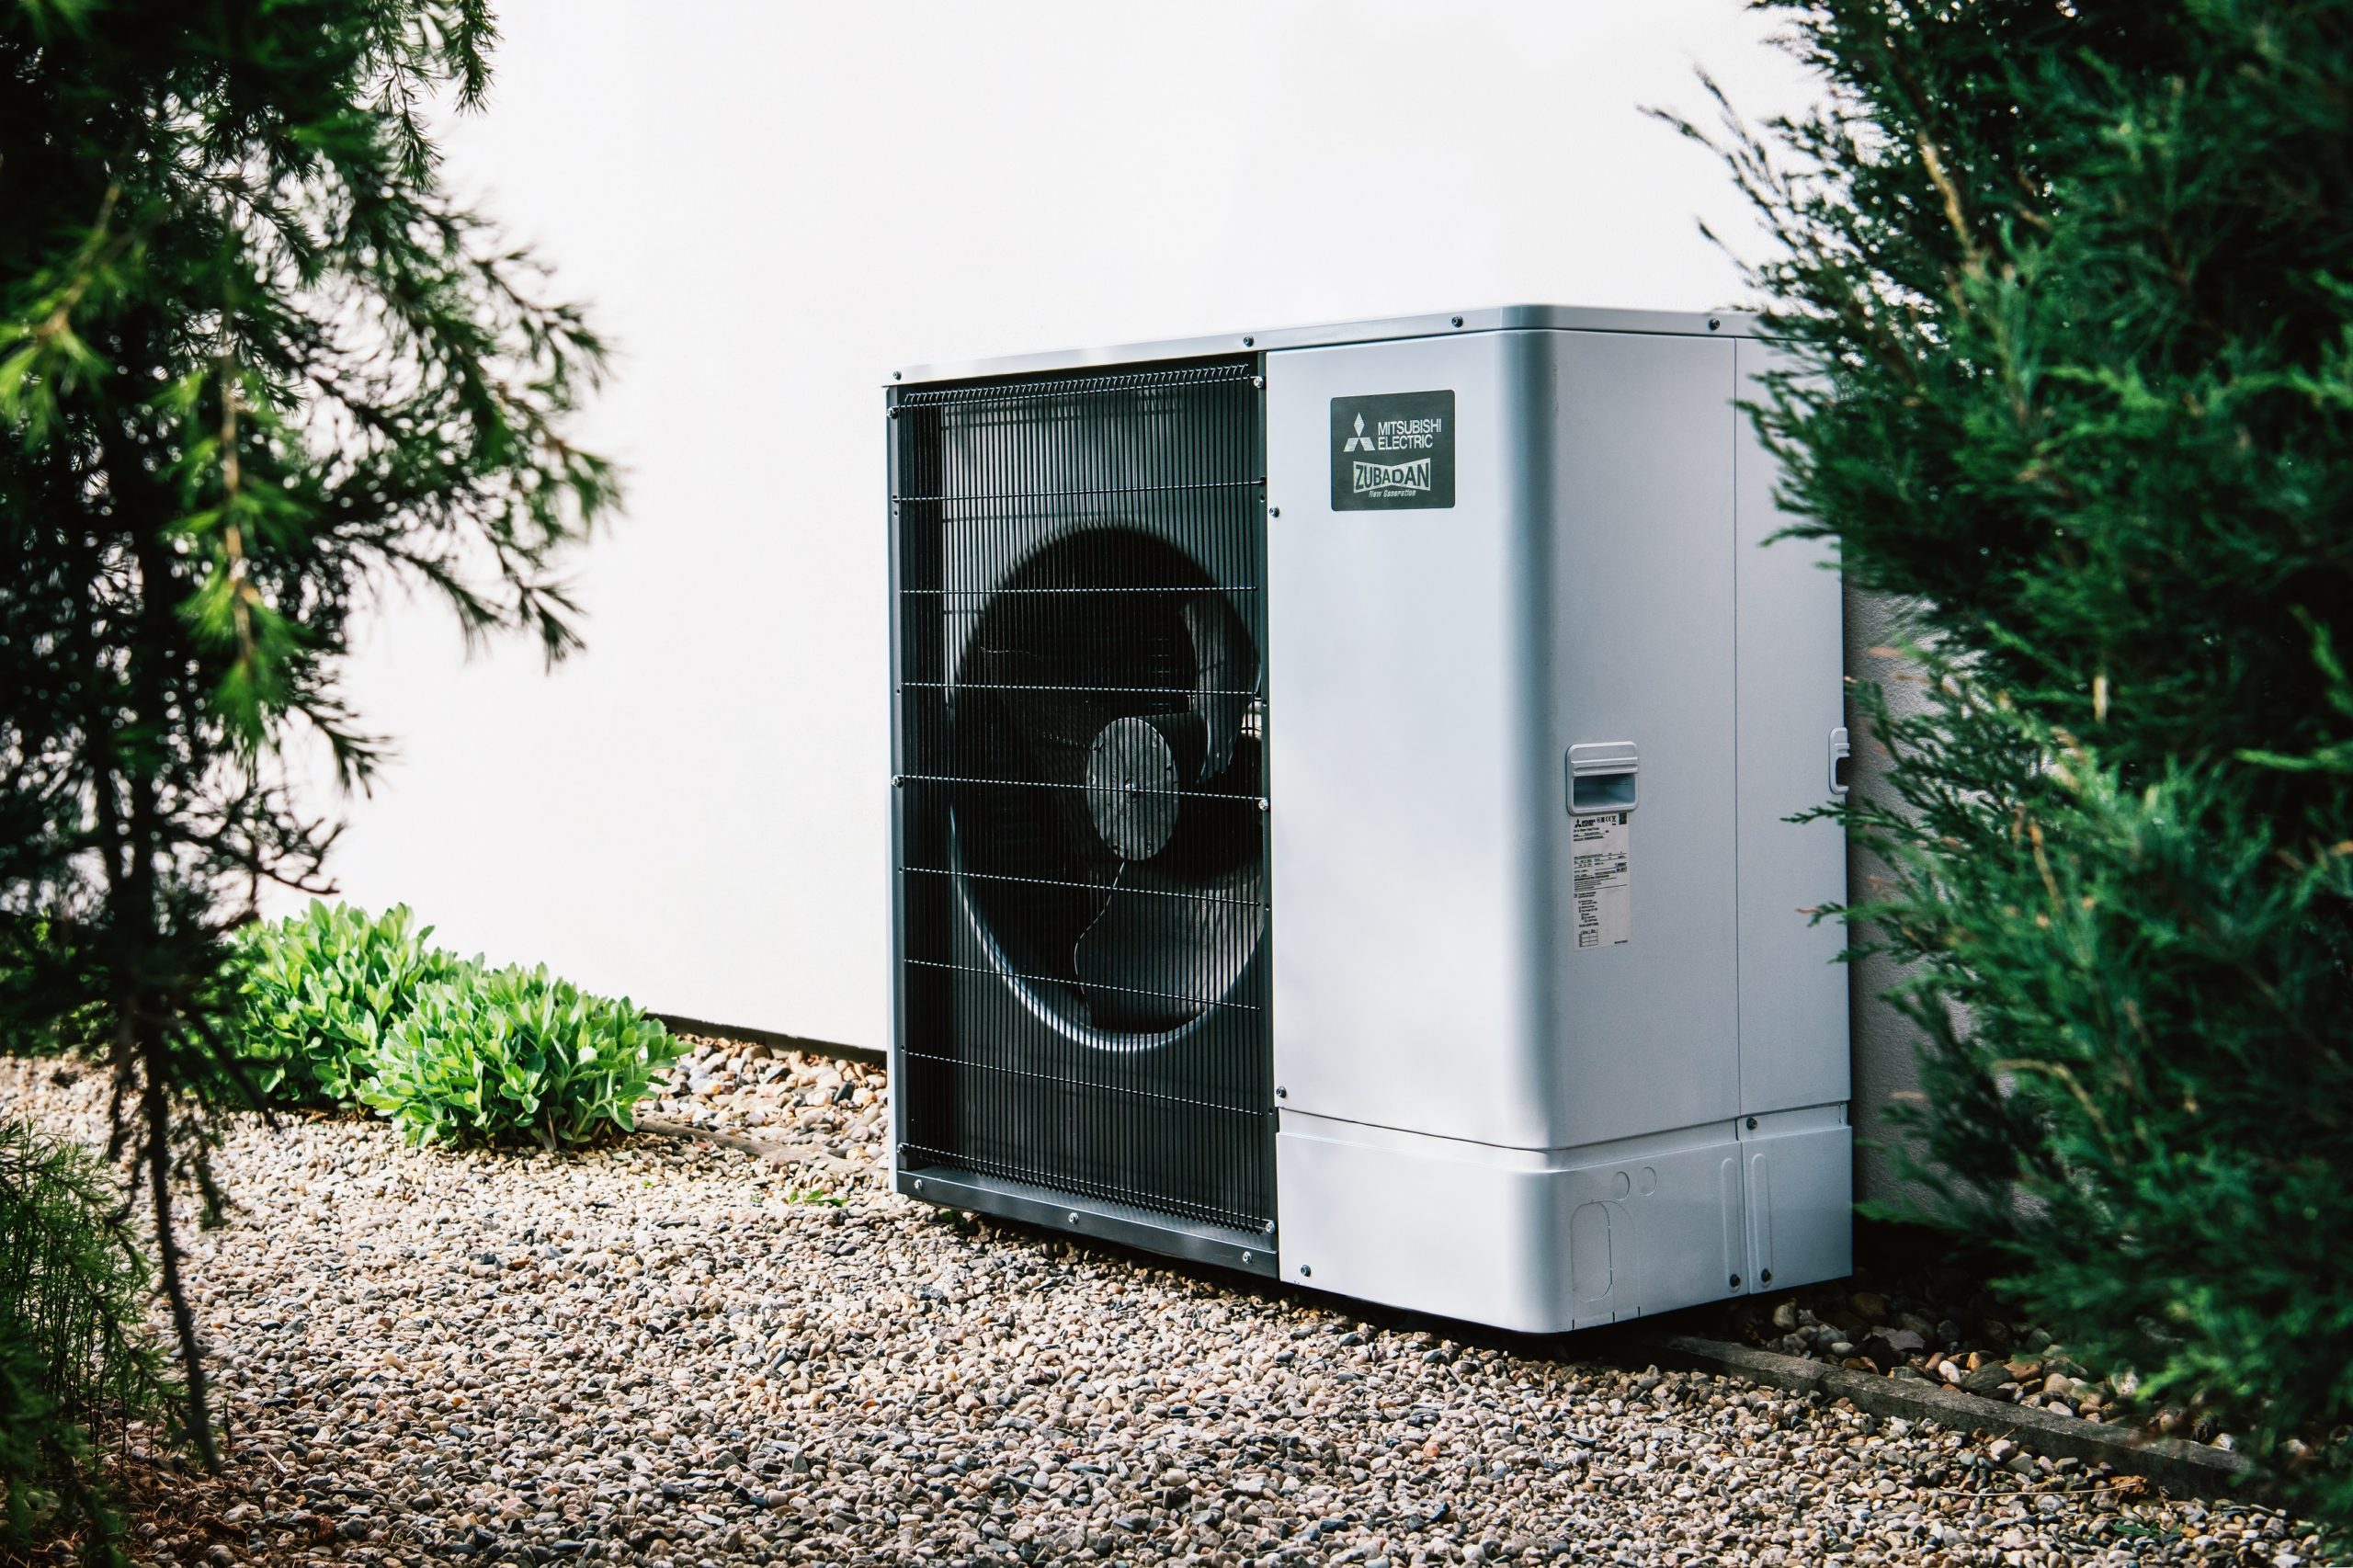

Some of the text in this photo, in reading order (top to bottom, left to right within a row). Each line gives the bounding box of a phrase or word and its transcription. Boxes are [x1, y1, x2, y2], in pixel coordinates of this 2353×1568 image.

[1378, 418, 1442, 436] MITSUBISHI
[1378, 434, 1434, 450] ELECTRIC
[1355, 462, 1430, 491] ZUBADAN
[1382, 489, 1416, 497] Generation
